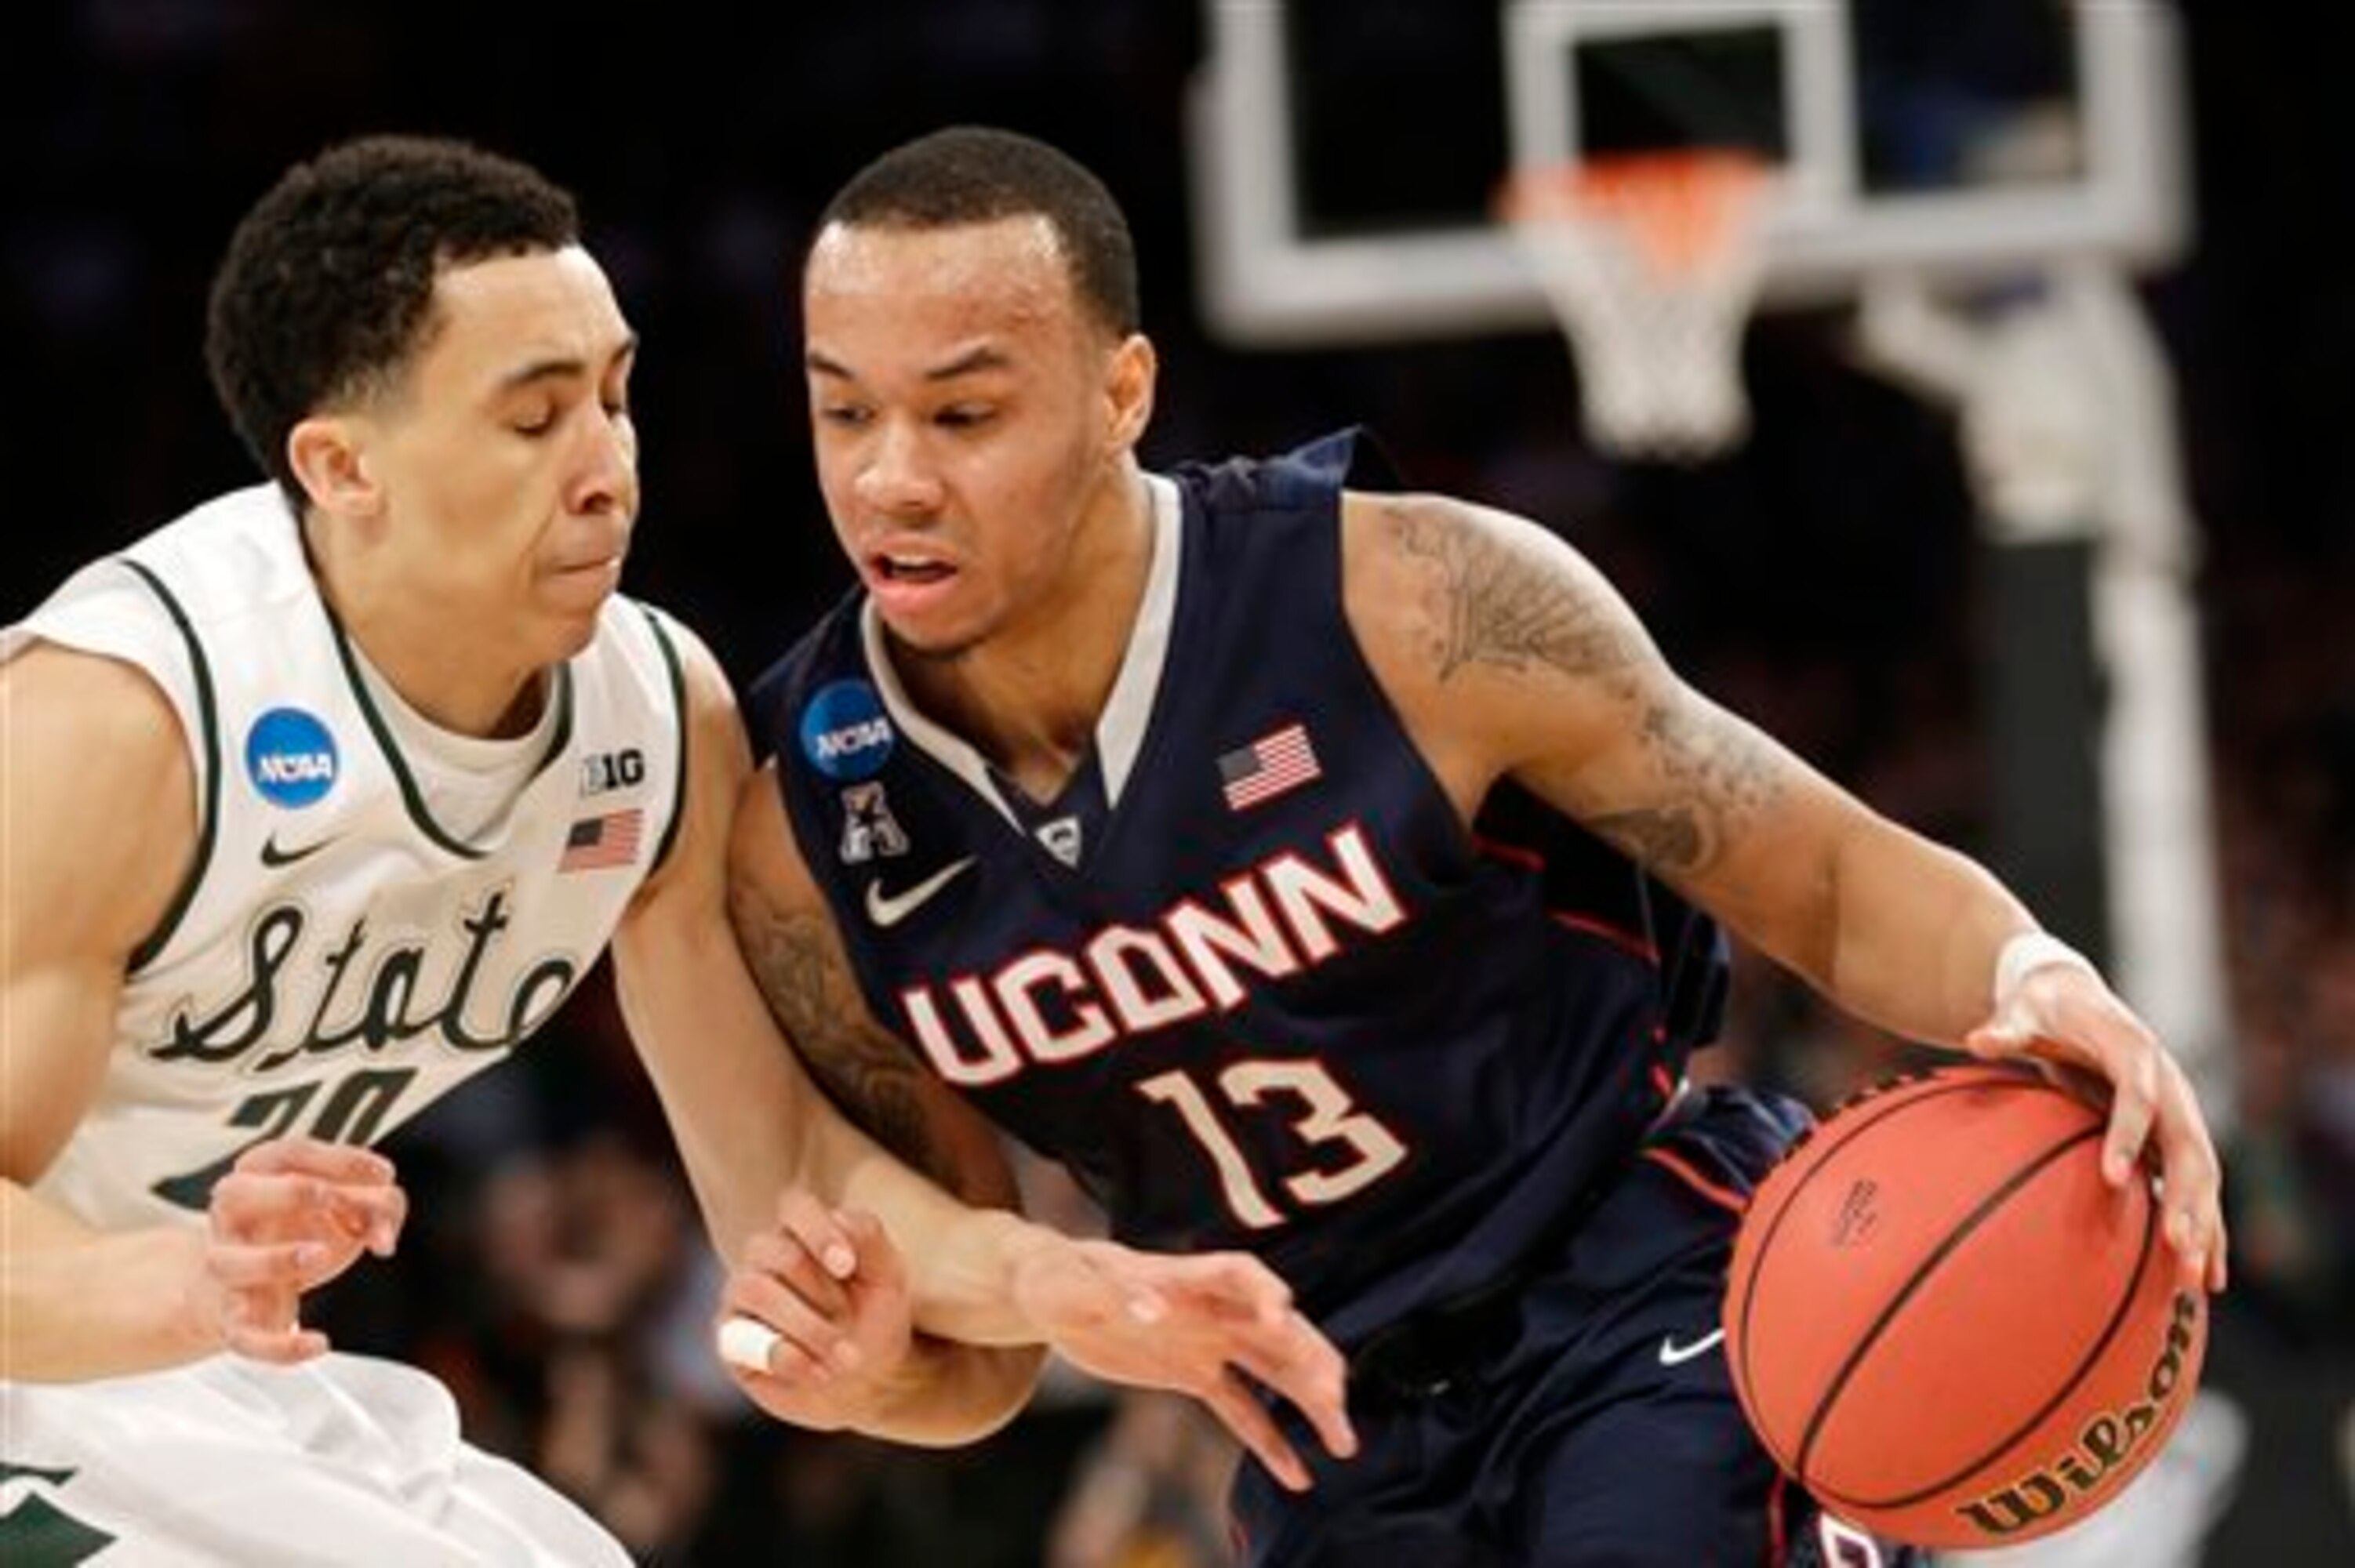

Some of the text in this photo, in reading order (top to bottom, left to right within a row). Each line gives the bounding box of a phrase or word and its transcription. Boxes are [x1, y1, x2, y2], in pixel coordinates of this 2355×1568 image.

[260, 753, 333, 782] NCAA
[817, 716, 893, 759] NCAA
[147, 891, 576, 1072] State
[900, 823, 1409, 1088] UCONN
[1132, 1057, 1411, 1230] 13
[1955, 1287, 2199, 1534] Wilson
